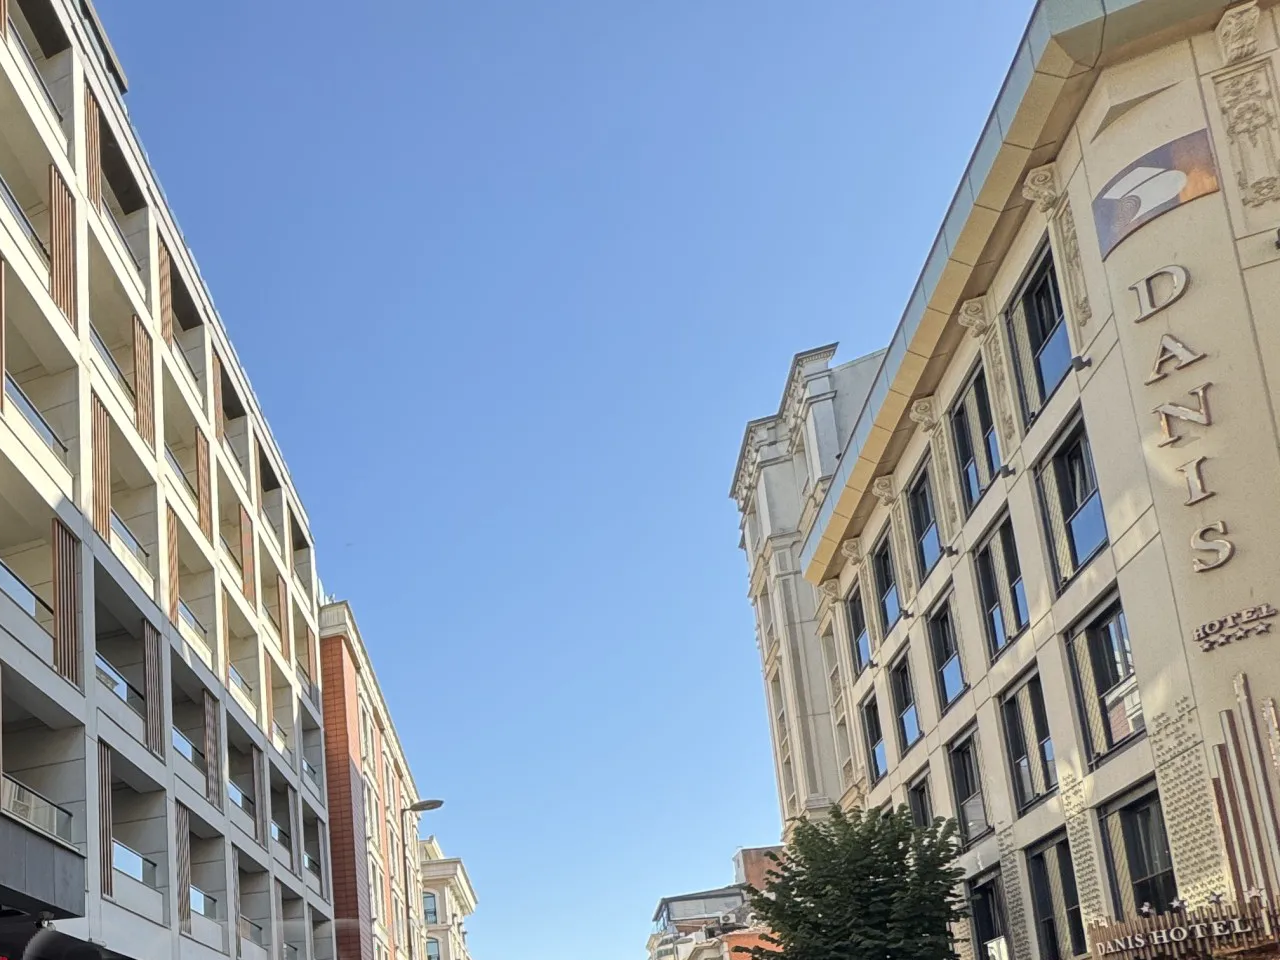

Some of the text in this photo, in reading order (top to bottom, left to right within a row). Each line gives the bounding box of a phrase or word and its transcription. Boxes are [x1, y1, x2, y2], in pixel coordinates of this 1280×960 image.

[1128, 264, 1236, 573] DANIS
[1193, 603, 1278, 642] HOTEL
[1095, 917, 1253, 957] DANIS HOTEL
